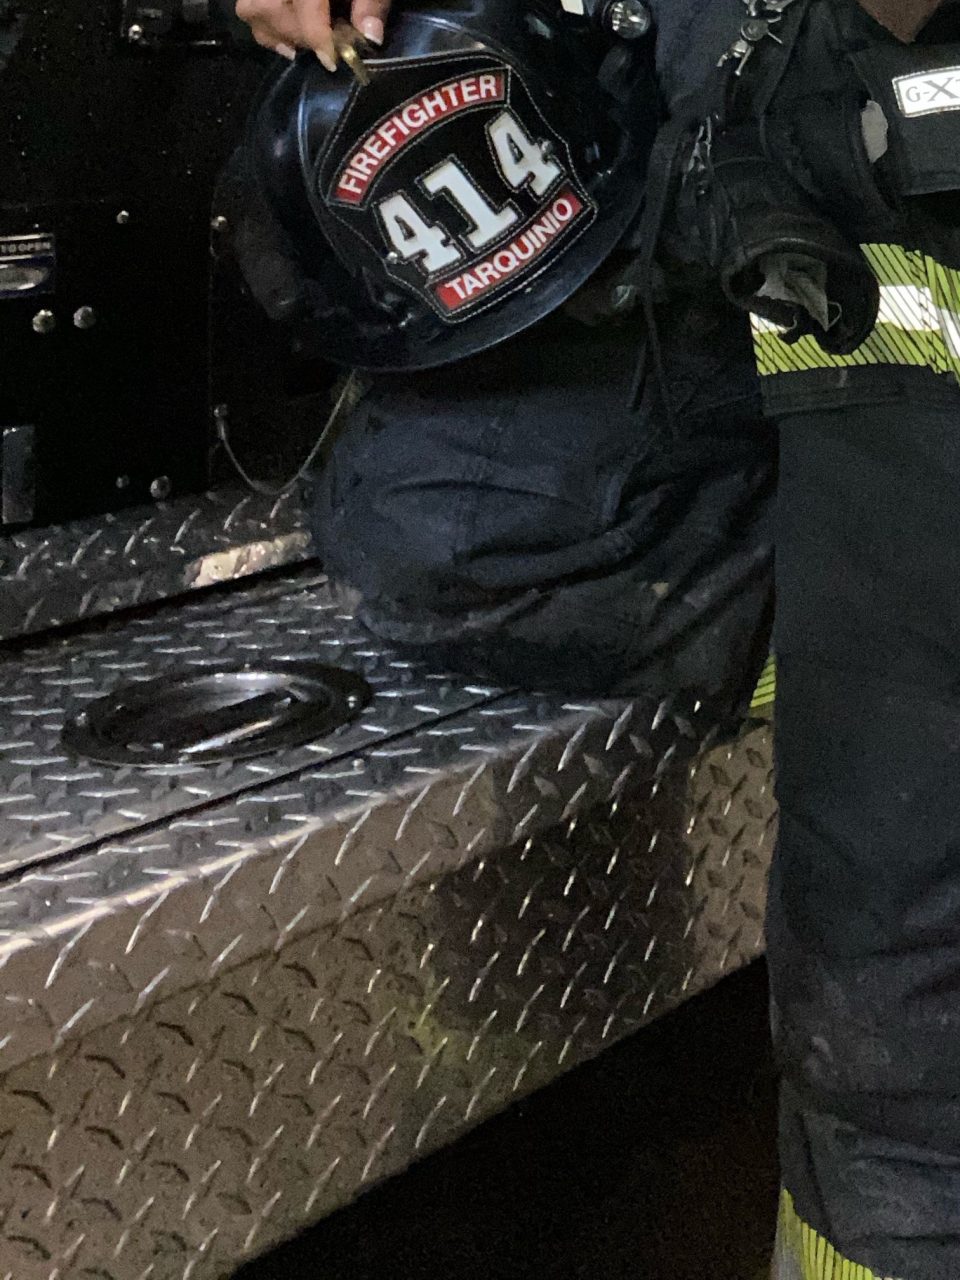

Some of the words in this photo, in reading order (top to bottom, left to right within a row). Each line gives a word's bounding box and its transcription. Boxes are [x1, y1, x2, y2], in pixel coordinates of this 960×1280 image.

[338, 74, 498, 195] FIREFIGHTER
[378, 112, 564, 272] 414
[445, 198, 574, 300] TARQUINIO
